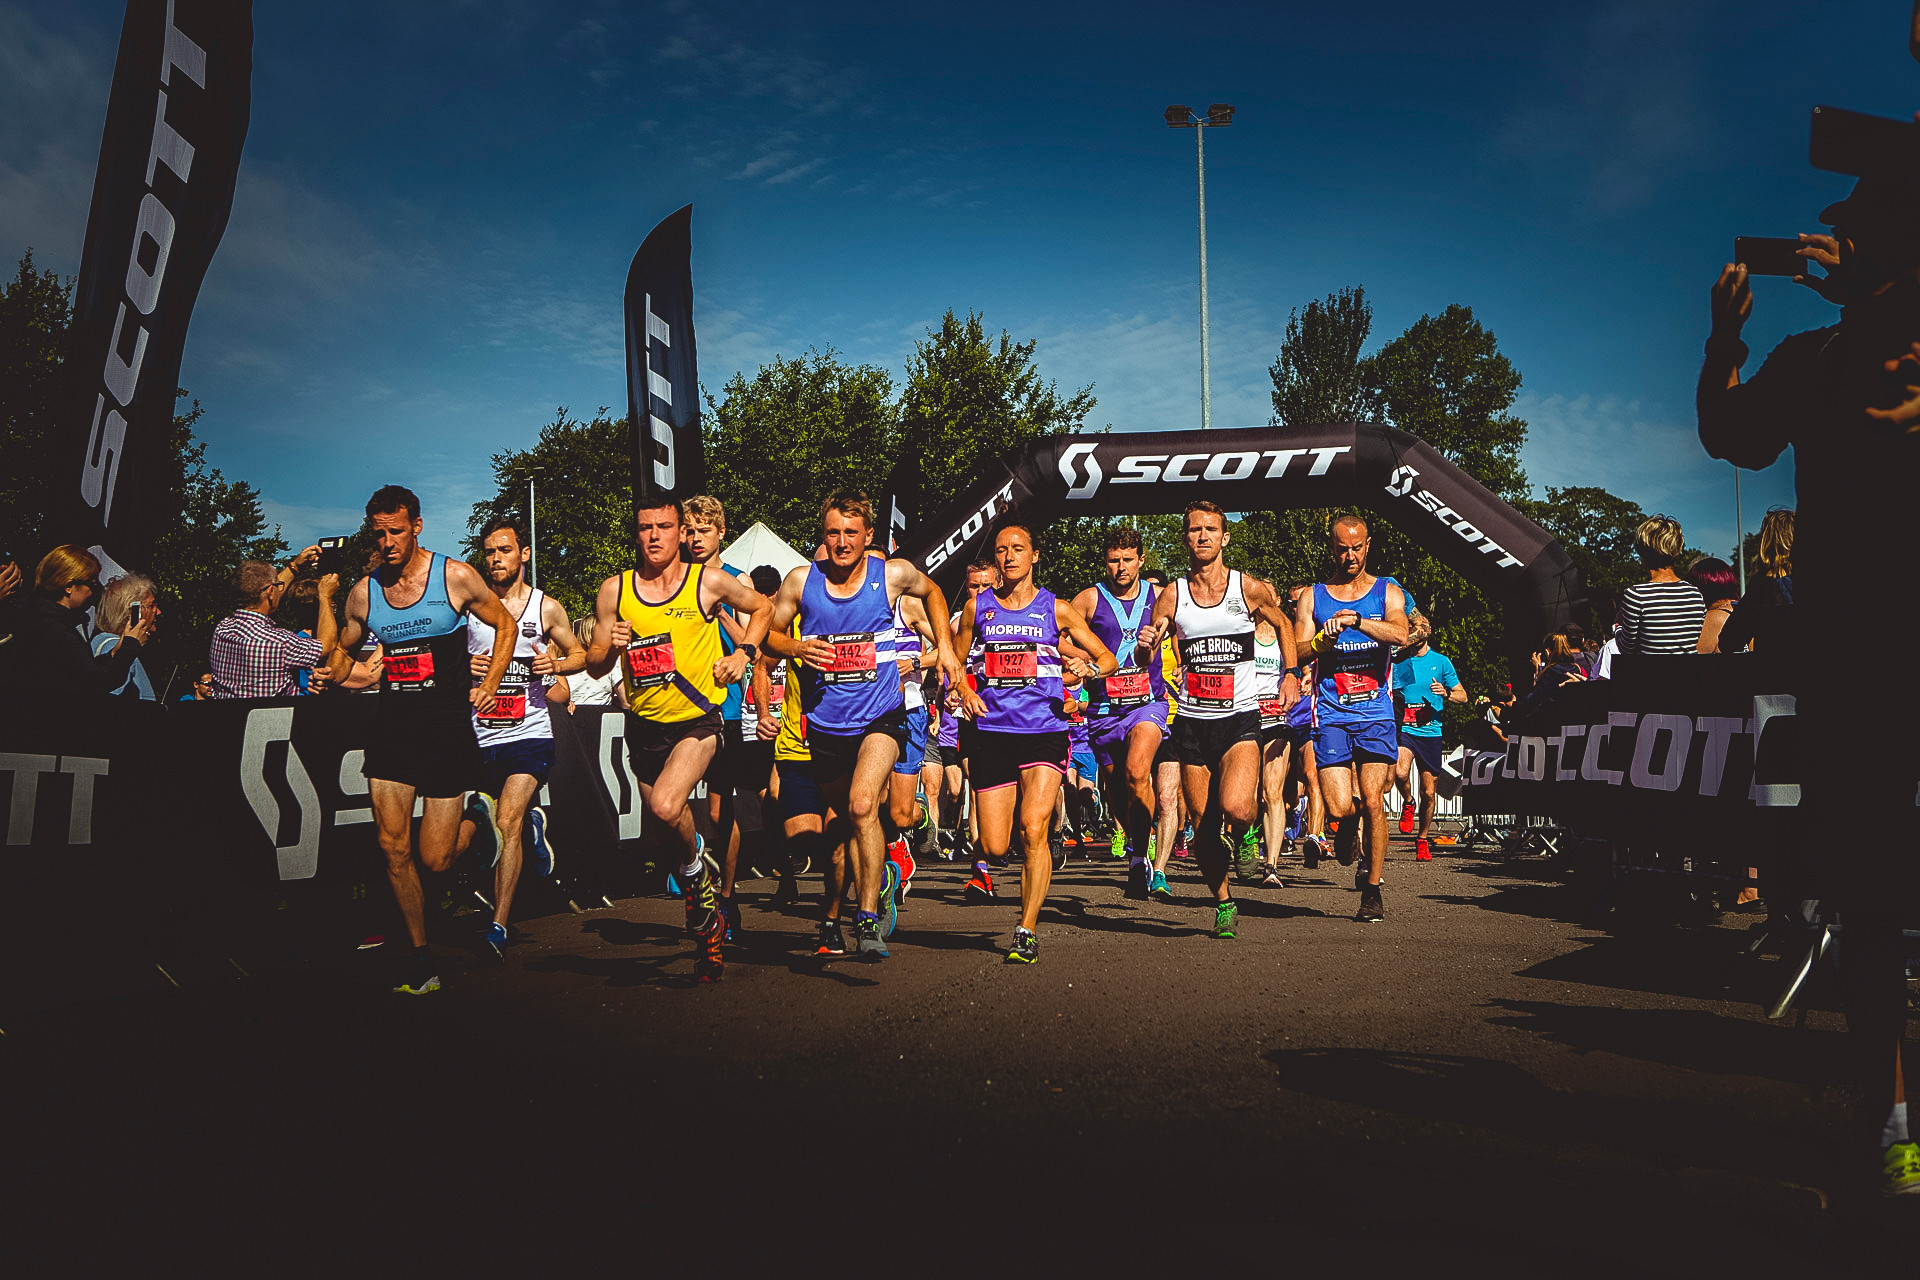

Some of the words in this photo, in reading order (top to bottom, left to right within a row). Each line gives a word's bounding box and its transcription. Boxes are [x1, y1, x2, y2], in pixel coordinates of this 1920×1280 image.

[80, 0, 207, 528] SCOTT
[1109, 446, 1352, 484] SCOTT
[925, 478, 1014, 575] SCOTT
[1410, 489, 1525, 569] SCOTT
[381, 617, 432, 634] PONTELAND
[985, 624, 1043, 638] MORPETH
[387, 626, 427, 640] RUNNERS
[631, 636, 660, 647] SCOTT
[1207, 637, 1243, 654] BRIDGE
[394, 646, 419, 654] SCOTT
[633, 648, 659, 664] 1451
[834, 644, 861, 659] 1442
[999, 653, 1024, 665] 1927
[1001, 666, 1022, 674] Jane
[1122, 676, 1134, 687] 28
[1119, 686, 1140, 695] David
[1200, 687, 1218, 695] Paul
